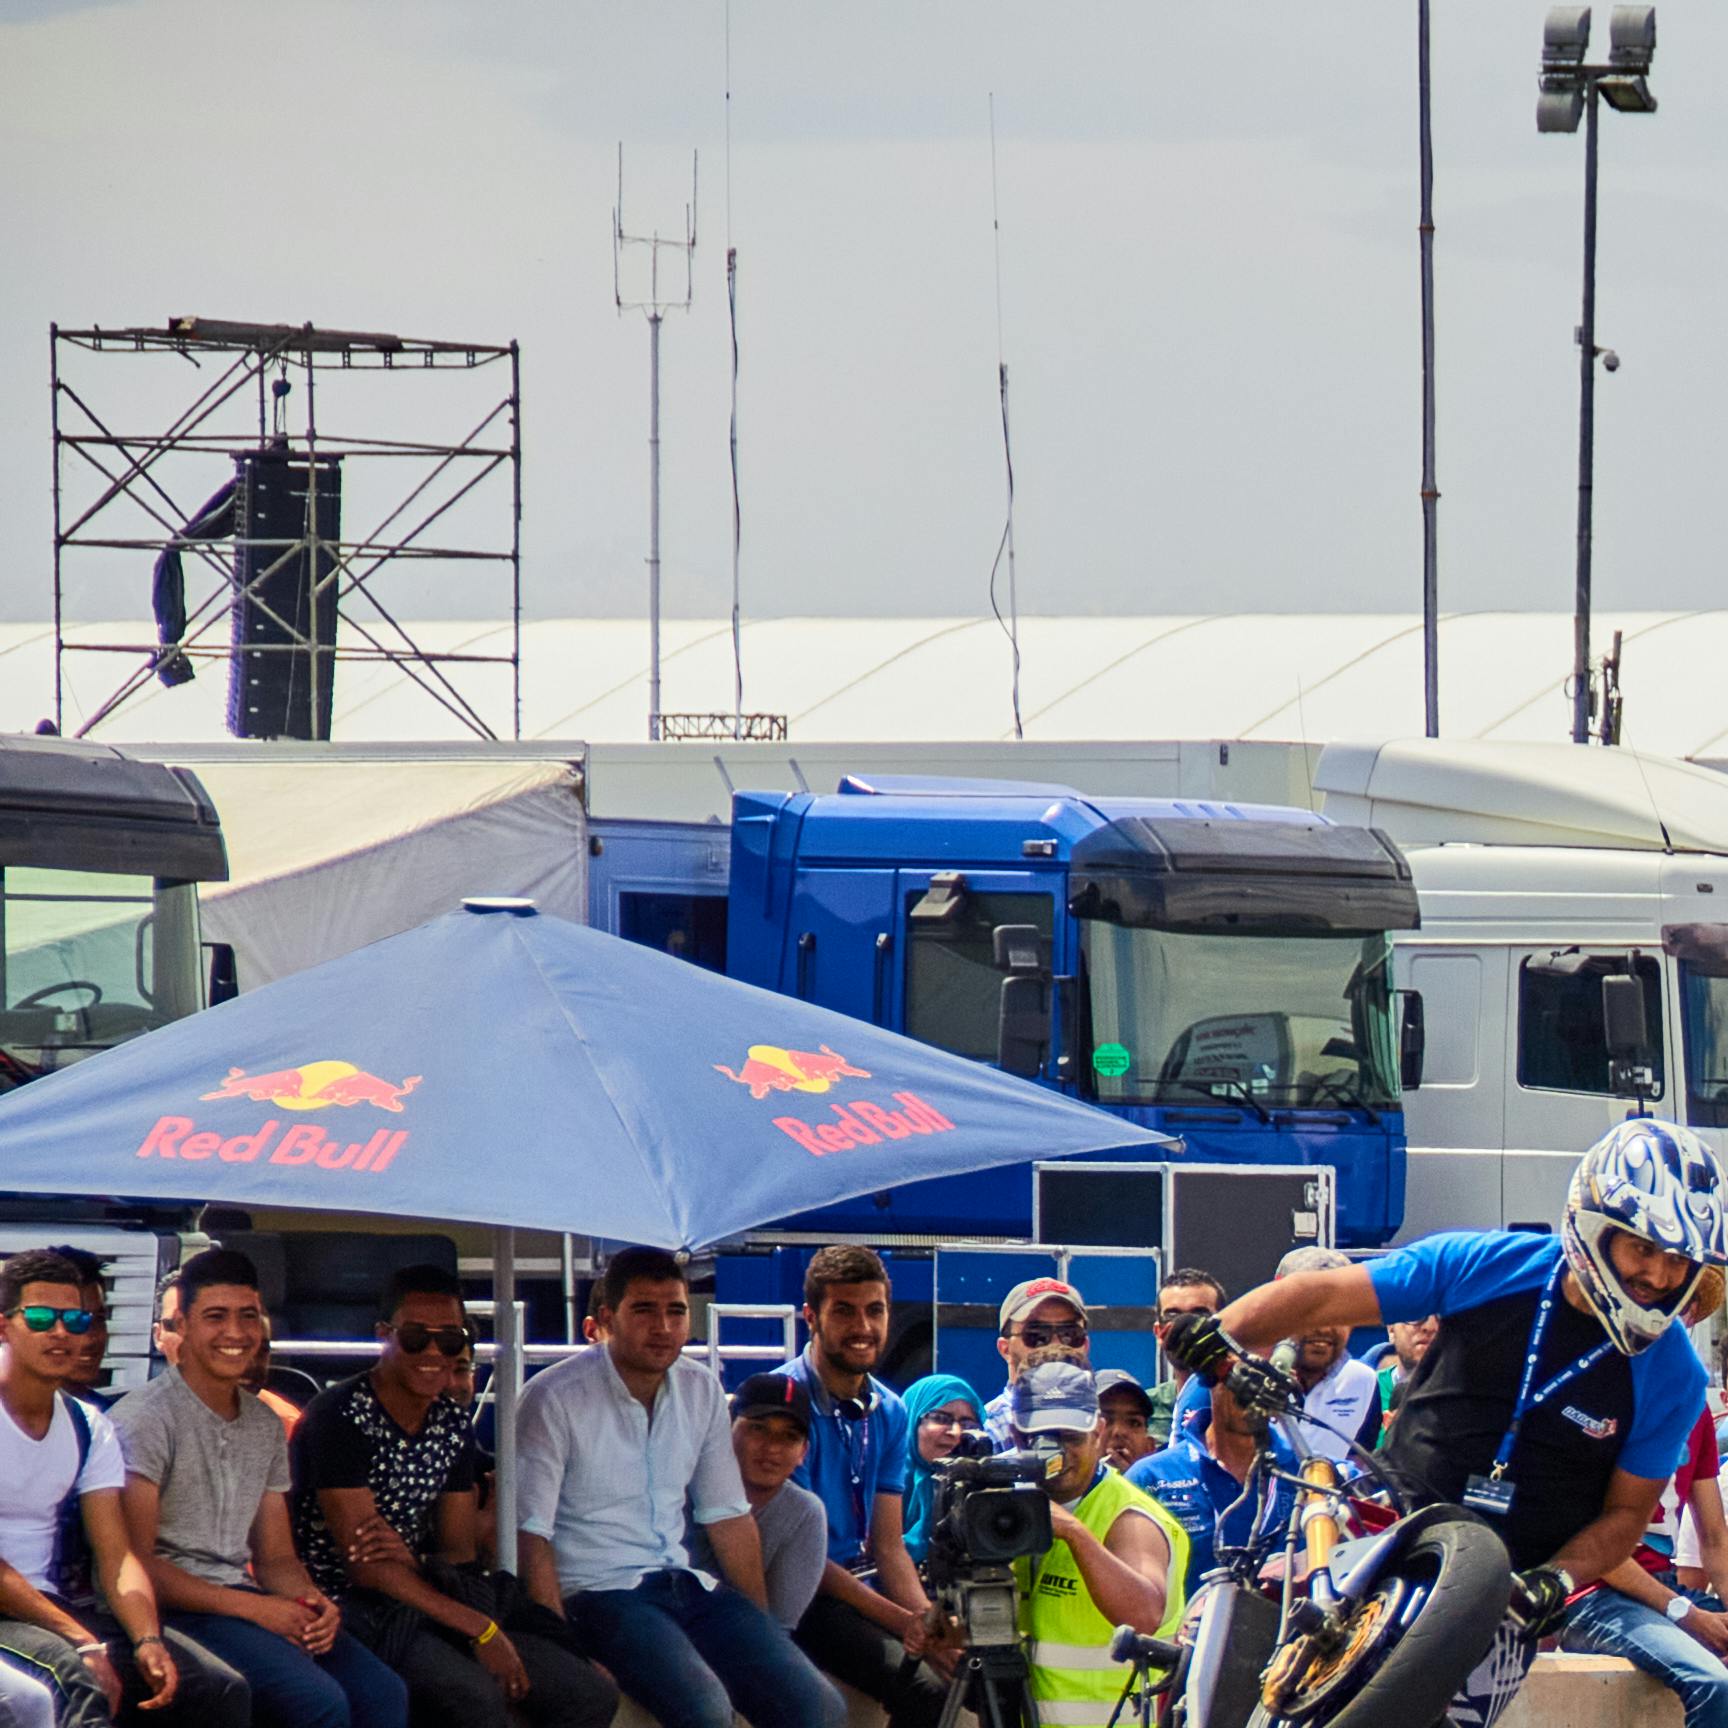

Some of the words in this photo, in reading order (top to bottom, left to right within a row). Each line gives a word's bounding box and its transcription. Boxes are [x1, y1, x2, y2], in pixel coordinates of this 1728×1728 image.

[137, 1116, 278, 1163] Red
[271, 1123, 409, 1173] Bull
[772, 1100, 868, 1157] Red
[850, 1092, 955, 1143] Bull
